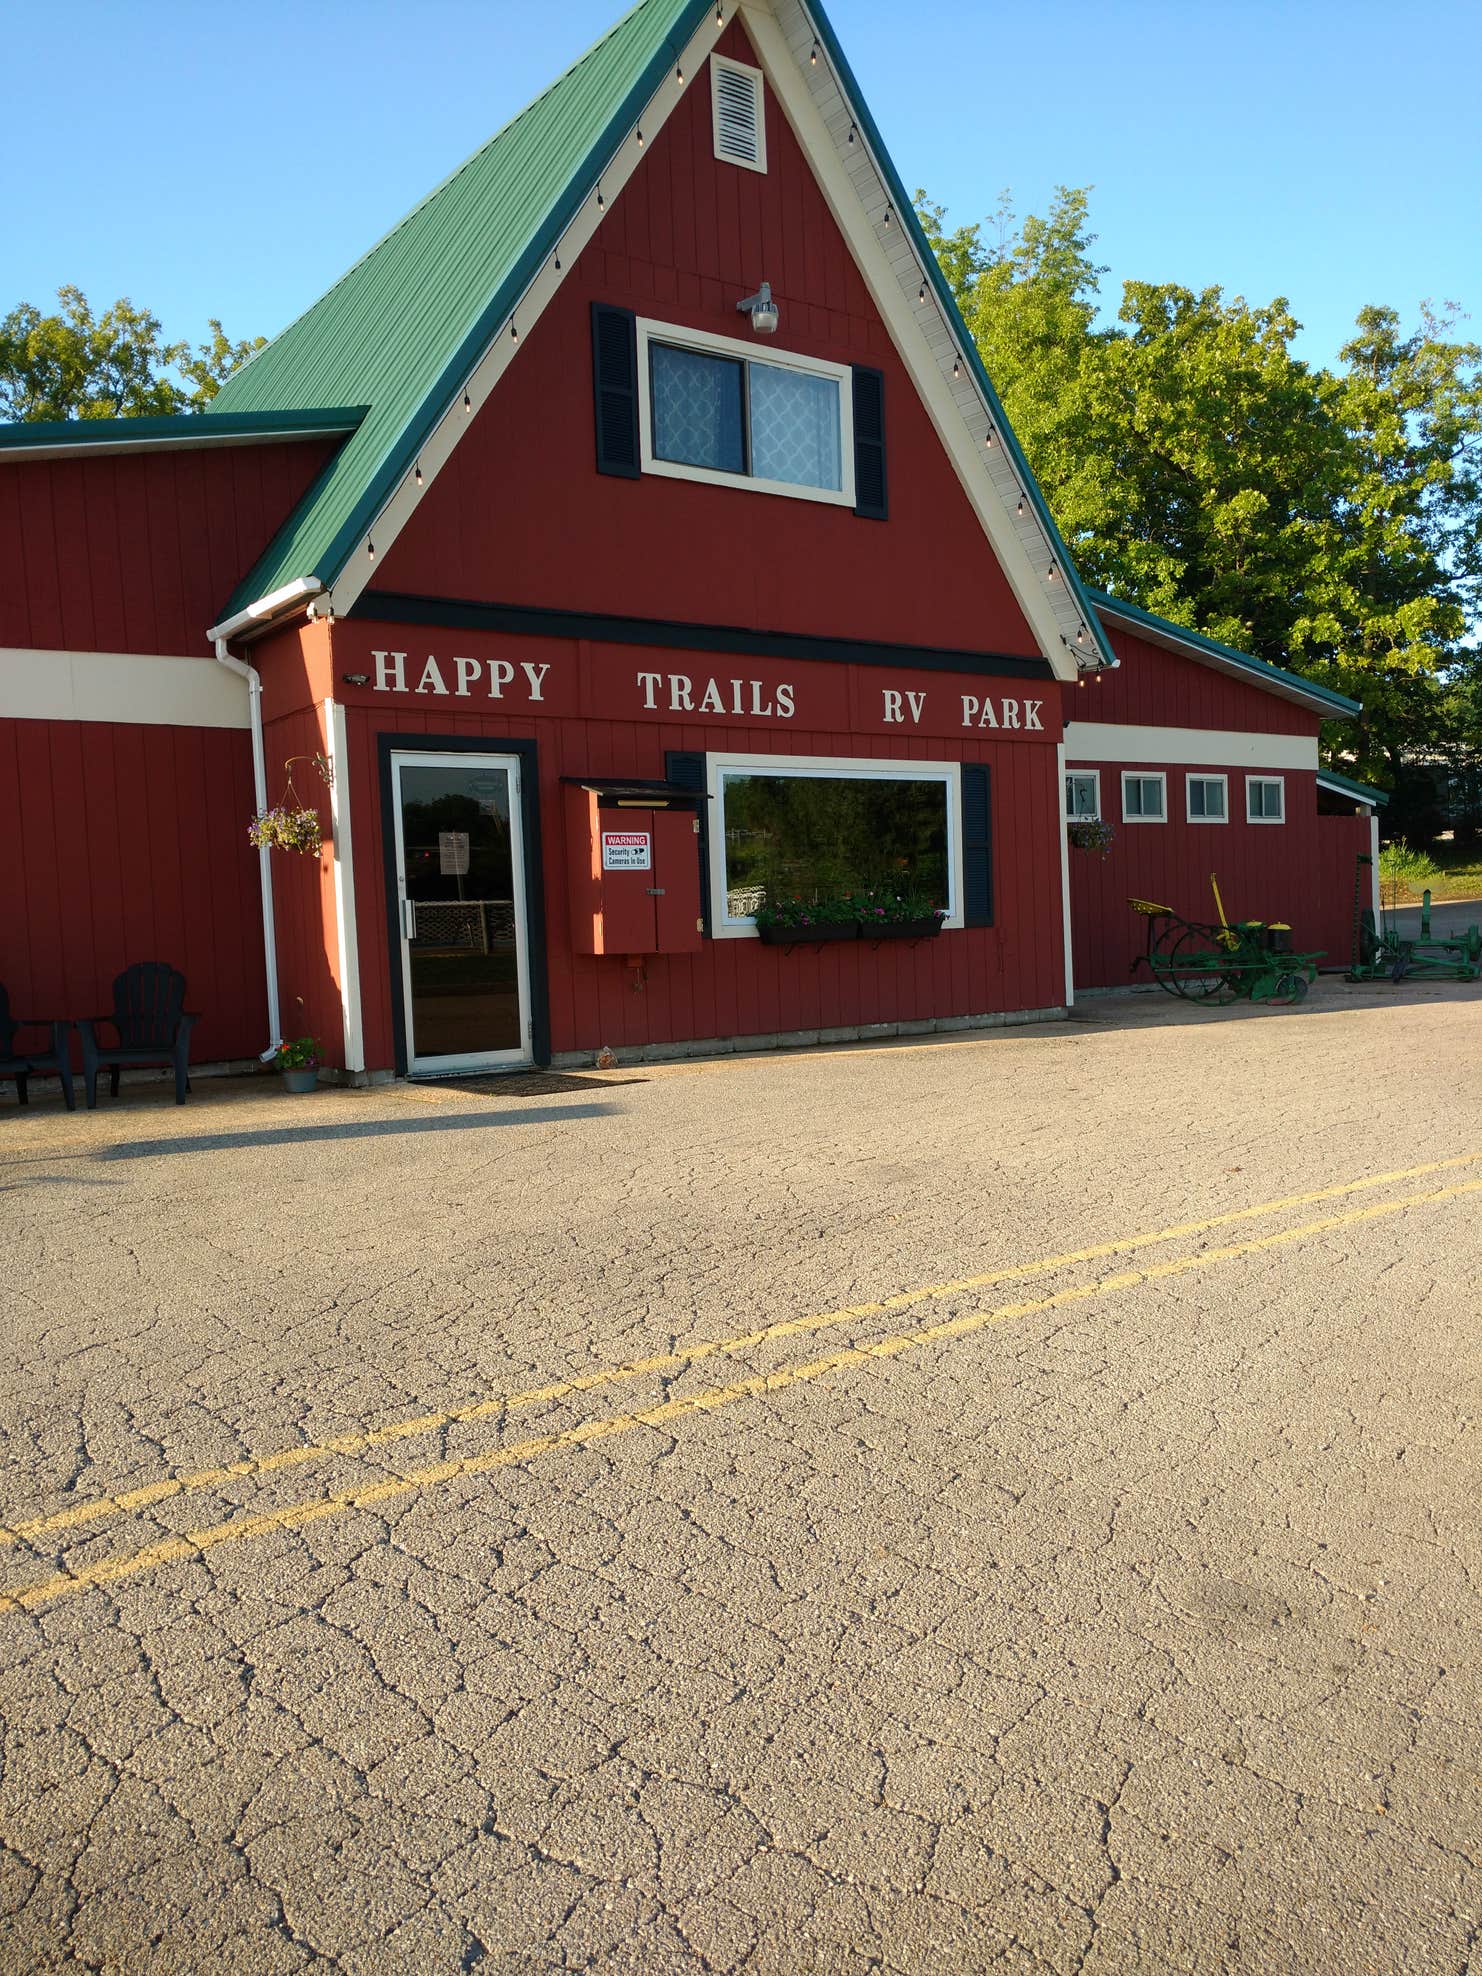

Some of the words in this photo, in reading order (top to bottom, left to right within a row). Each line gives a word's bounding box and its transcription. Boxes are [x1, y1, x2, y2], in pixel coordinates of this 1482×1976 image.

[371, 650, 551, 701] HAPPY
[637, 672, 796, 718] TRAILS
[882, 689, 927, 724] RV
[960, 695, 1045, 731] PARK
[607, 836, 646, 845] WARNING
[608, 847, 630, 856] Security
[608, 857, 630, 865] Cameras
[637, 857, 646, 865] Use
